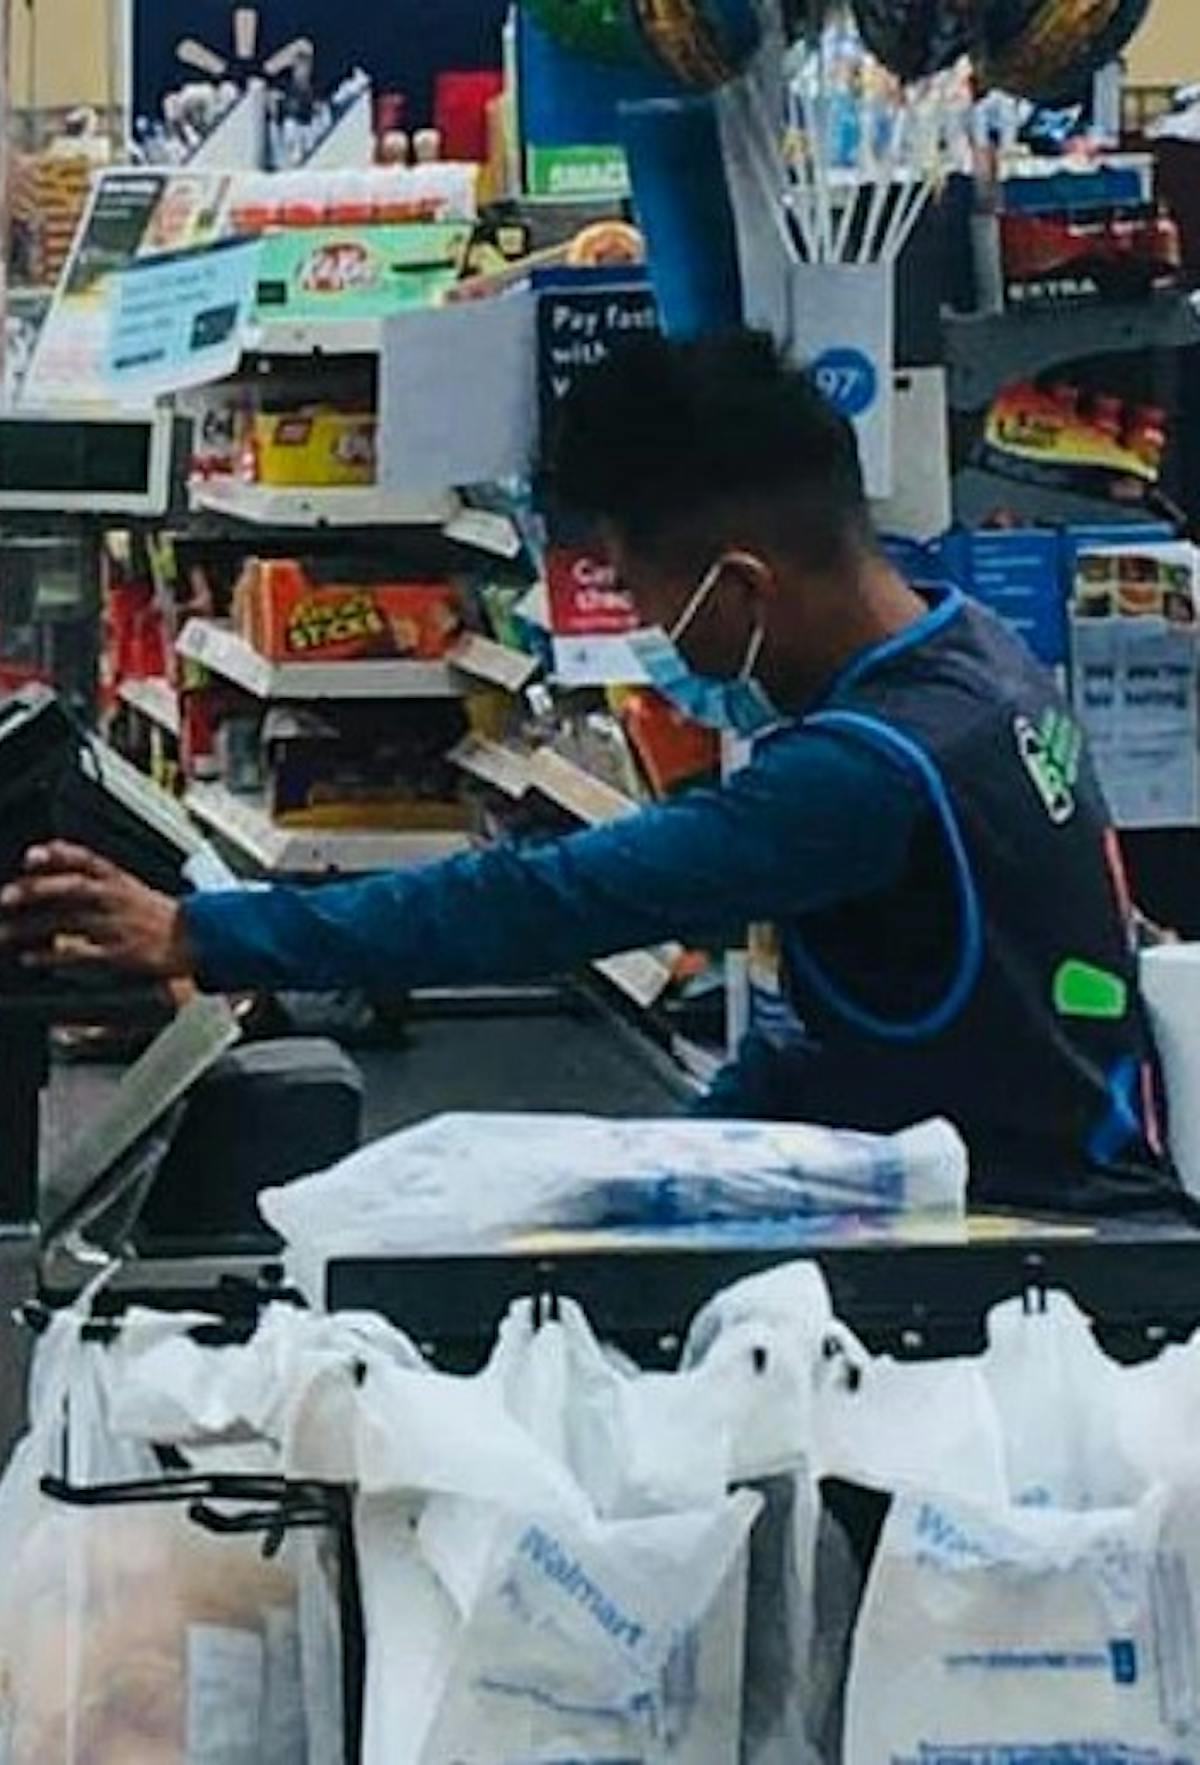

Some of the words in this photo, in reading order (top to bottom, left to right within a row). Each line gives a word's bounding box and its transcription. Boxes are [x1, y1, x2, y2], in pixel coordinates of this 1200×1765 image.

[1006, 277, 1098, 300] EXTRA
[553, 304, 598, 338] Pay
[517, 1526, 642, 1648] Walmart
